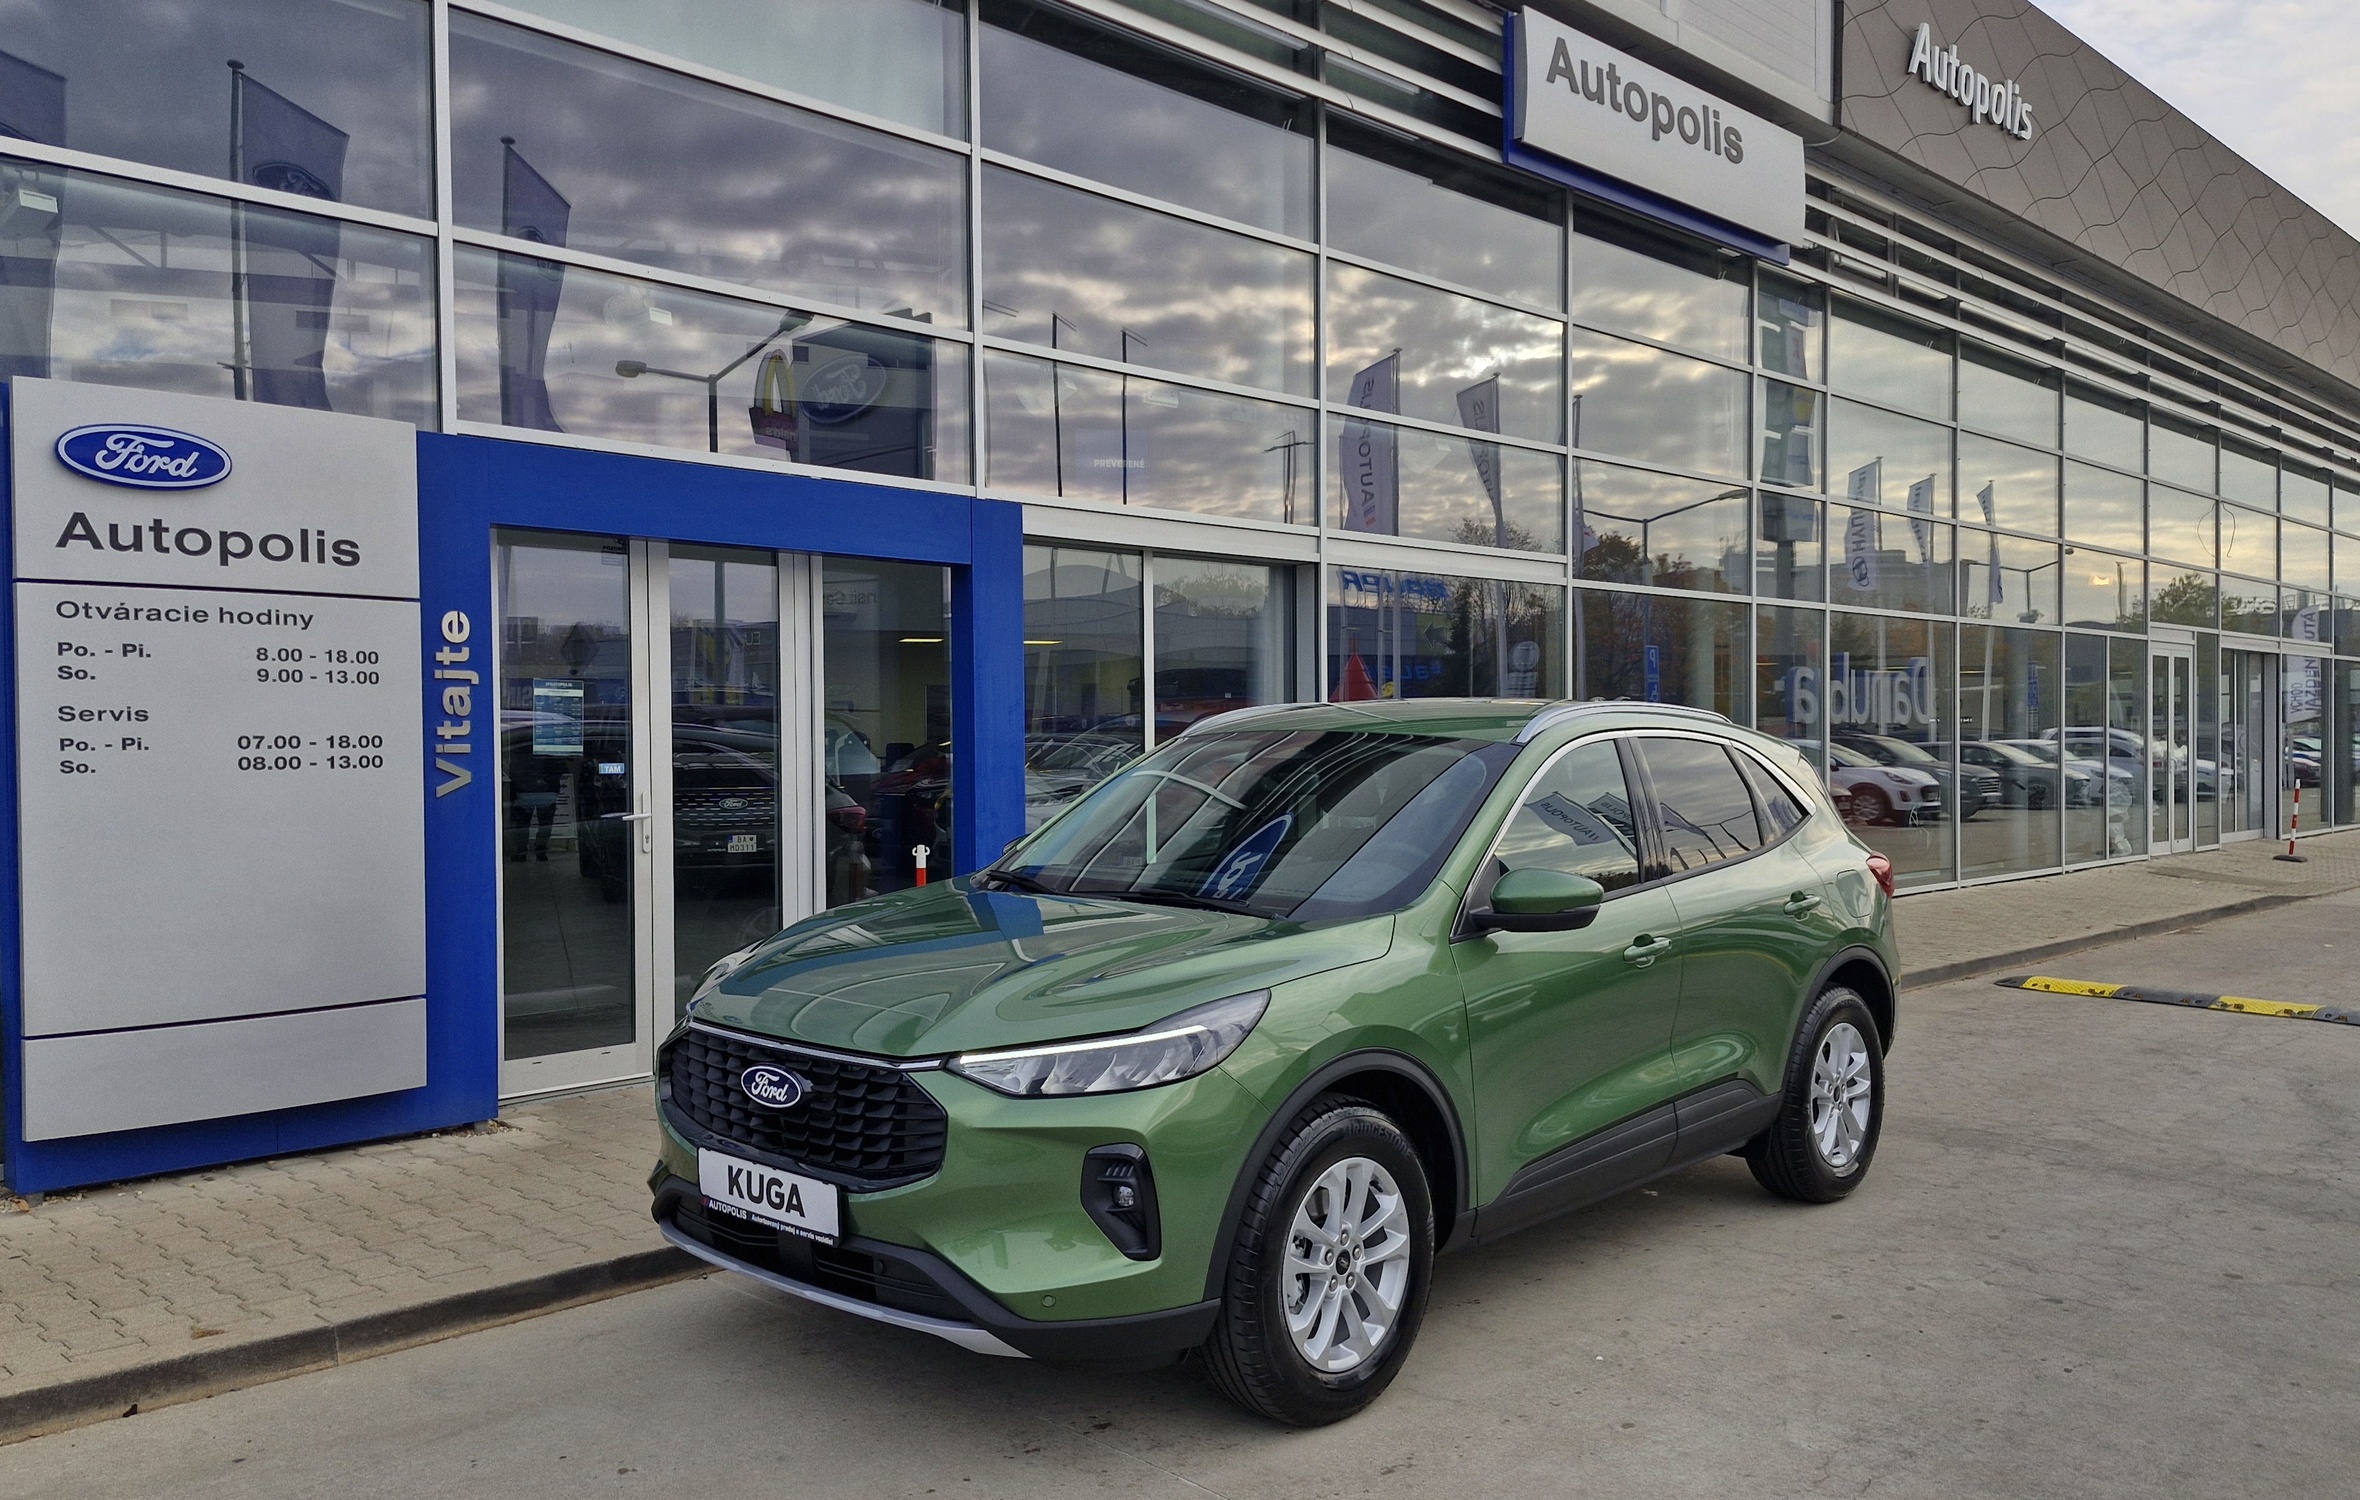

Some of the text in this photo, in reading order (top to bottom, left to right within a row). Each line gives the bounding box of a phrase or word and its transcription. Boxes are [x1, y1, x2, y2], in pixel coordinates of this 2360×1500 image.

[1908, 22, 2034, 141] Autopolis
[1546, 36, 1744, 164] Autopolis
[95, 432, 200, 478] Ford
[1094, 458, 1145, 469] PREVERENÉ
[55, 512, 361, 567] Autopolis
[56, 600, 314, 630] Otváracie hodiny
[57, 642, 96, 657] Po.
[122, 643, 152, 658] Pi.
[255, 648, 303, 663] 8.00
[324, 649, 379, 664] 18.00
[2301, 611, 2319, 712] JAZDEN UTÁ
[57, 665, 96, 681] So.
[256, 668, 303, 683] 9.00
[324, 670, 380, 684] 13.00
[434, 610, 479, 797] Vitajte
[57, 705, 150, 722] Servis
[59, 737, 96, 752] Po.
[121, 737, 150, 752] Pi.
[237, 735, 301, 750] 07.00
[325, 735, 384, 750] 18.00
[59, 759, 97, 774] So.
[237, 756, 301, 771] 08.00
[325, 755, 384, 770] 13.00
[604, 765, 620, 773] TAM
[751, 1070, 788, 1103] Ford
[727, 1164, 806, 1219] KUGA
[708, 1199, 748, 1220] AUTOPOLIS
